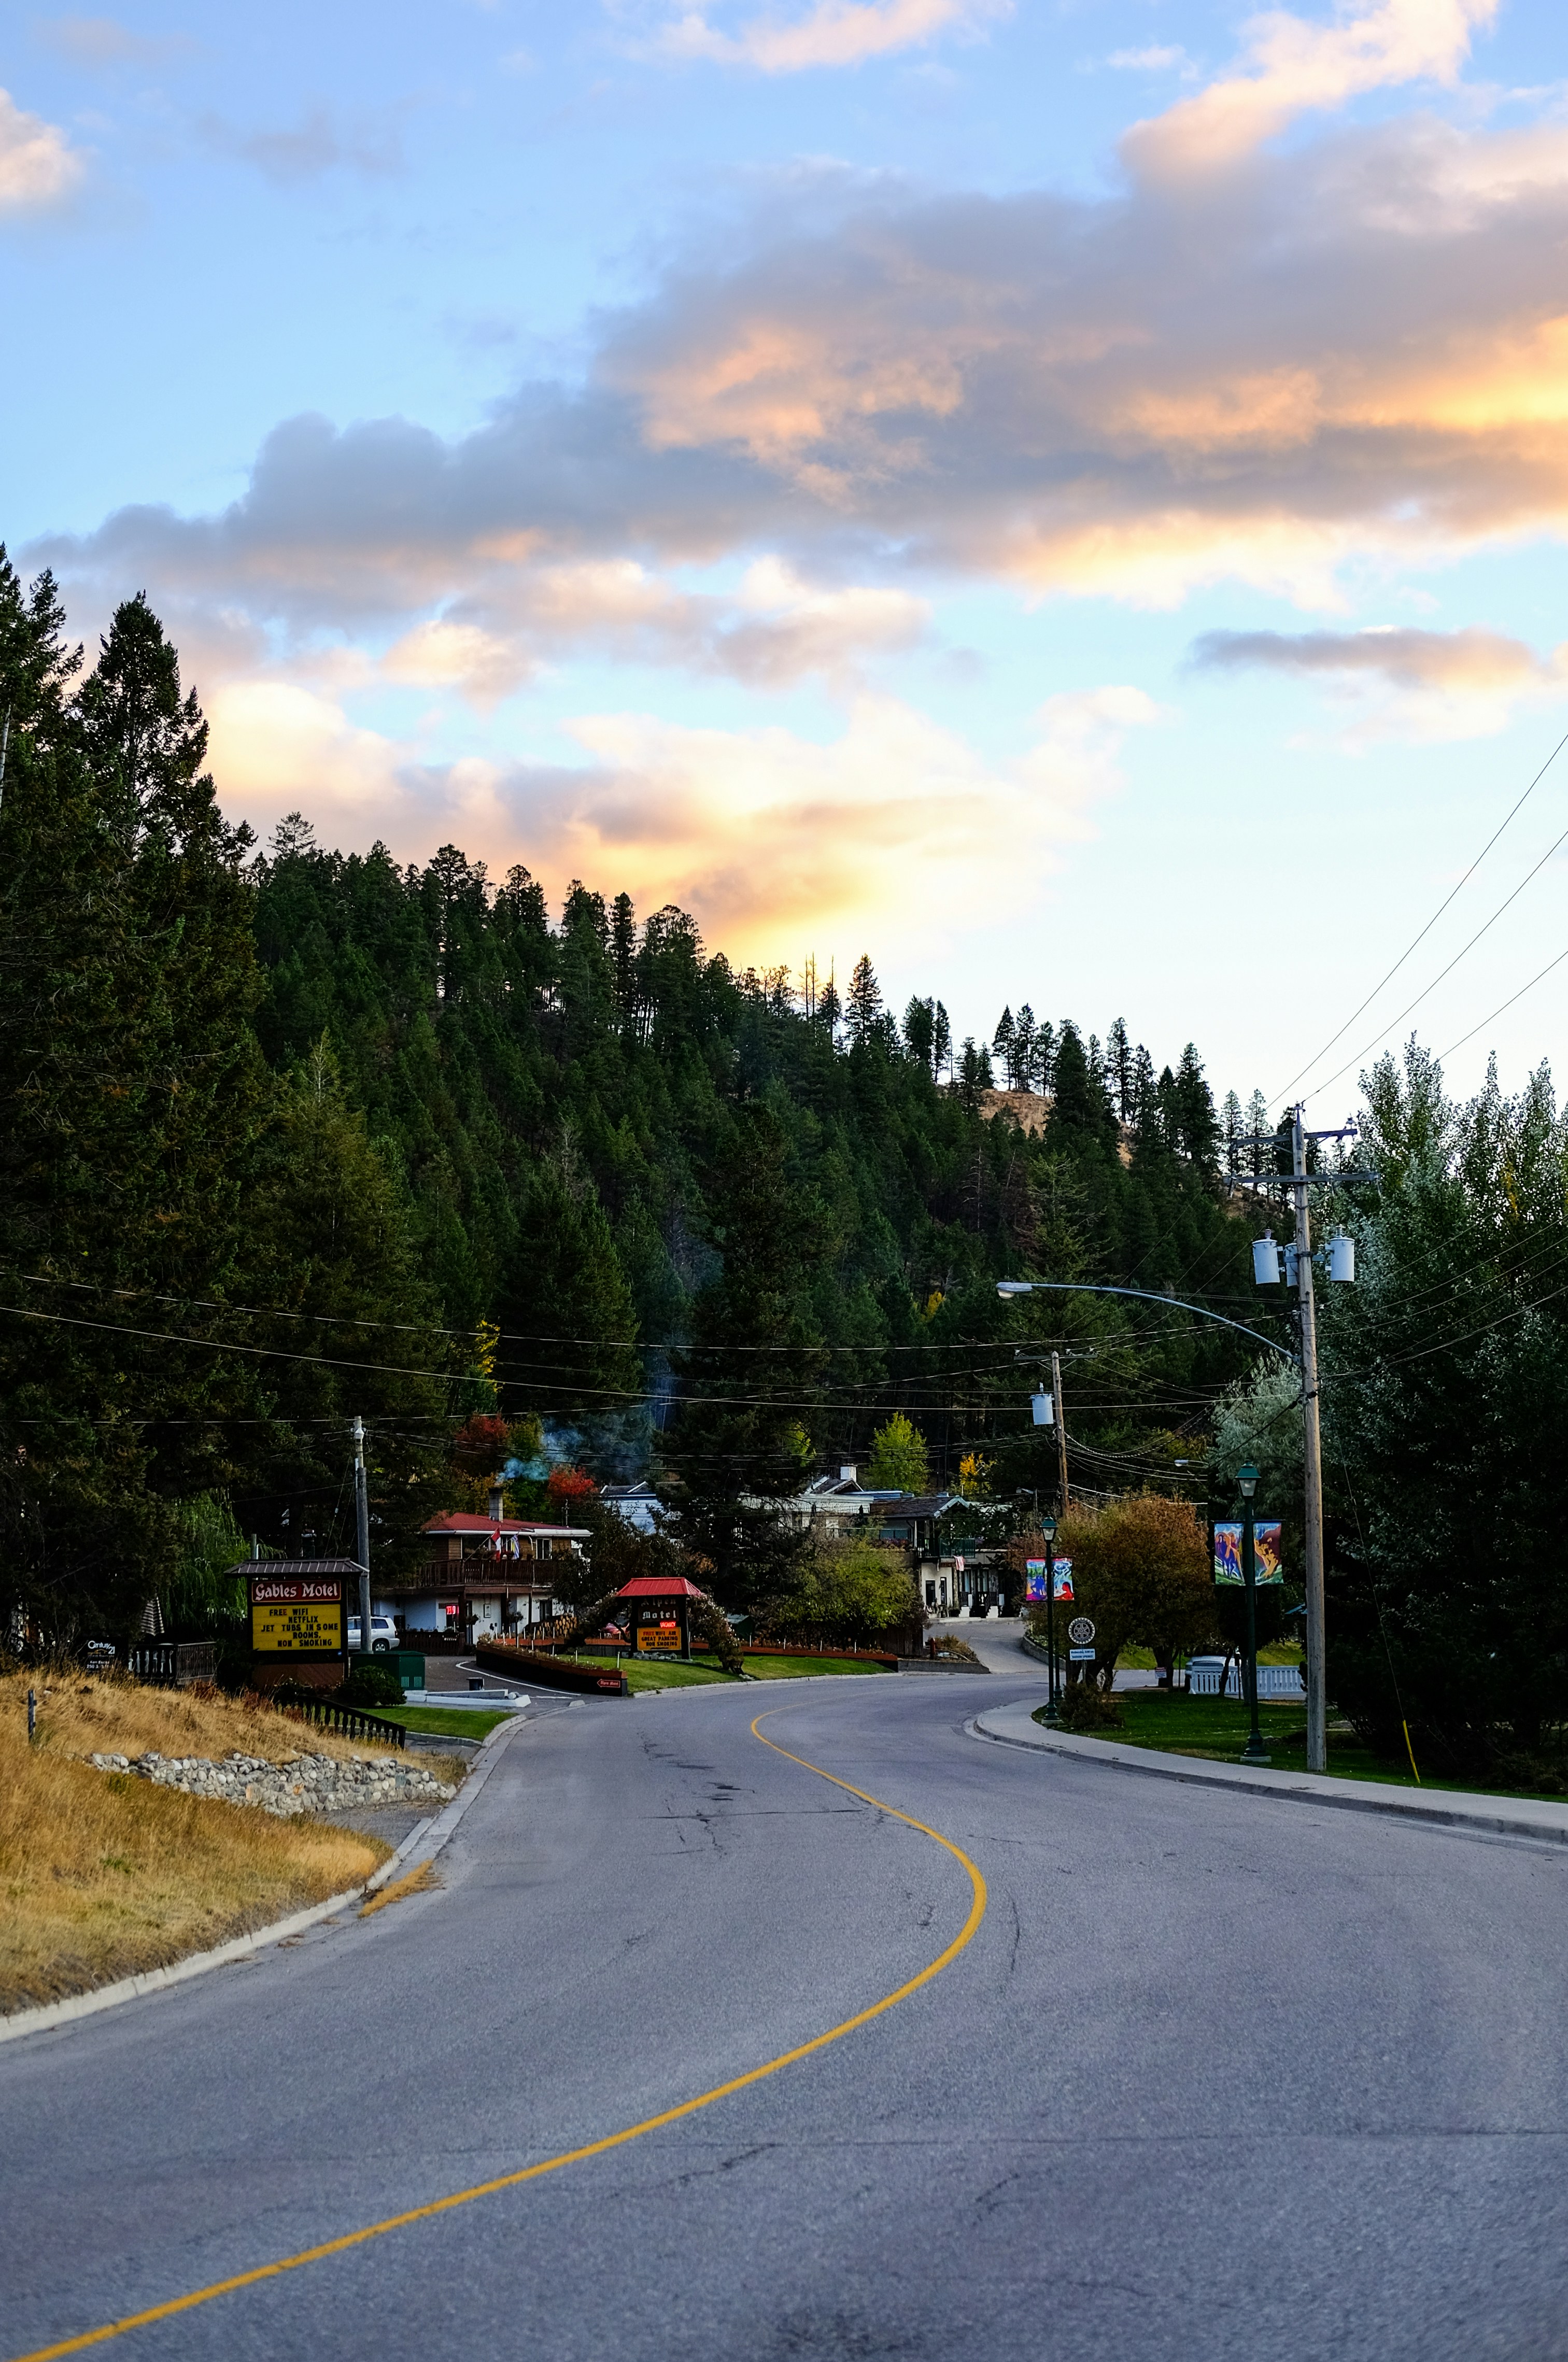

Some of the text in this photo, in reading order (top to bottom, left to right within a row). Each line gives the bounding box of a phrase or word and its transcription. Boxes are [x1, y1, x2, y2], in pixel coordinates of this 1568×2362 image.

[255, 1582, 338, 1601] Gables Motel
[641, 1597, 676, 1607] Alpen
[642, 1609, 676, 1620] Motel
[88, 1640, 116, 1654] Century 21
